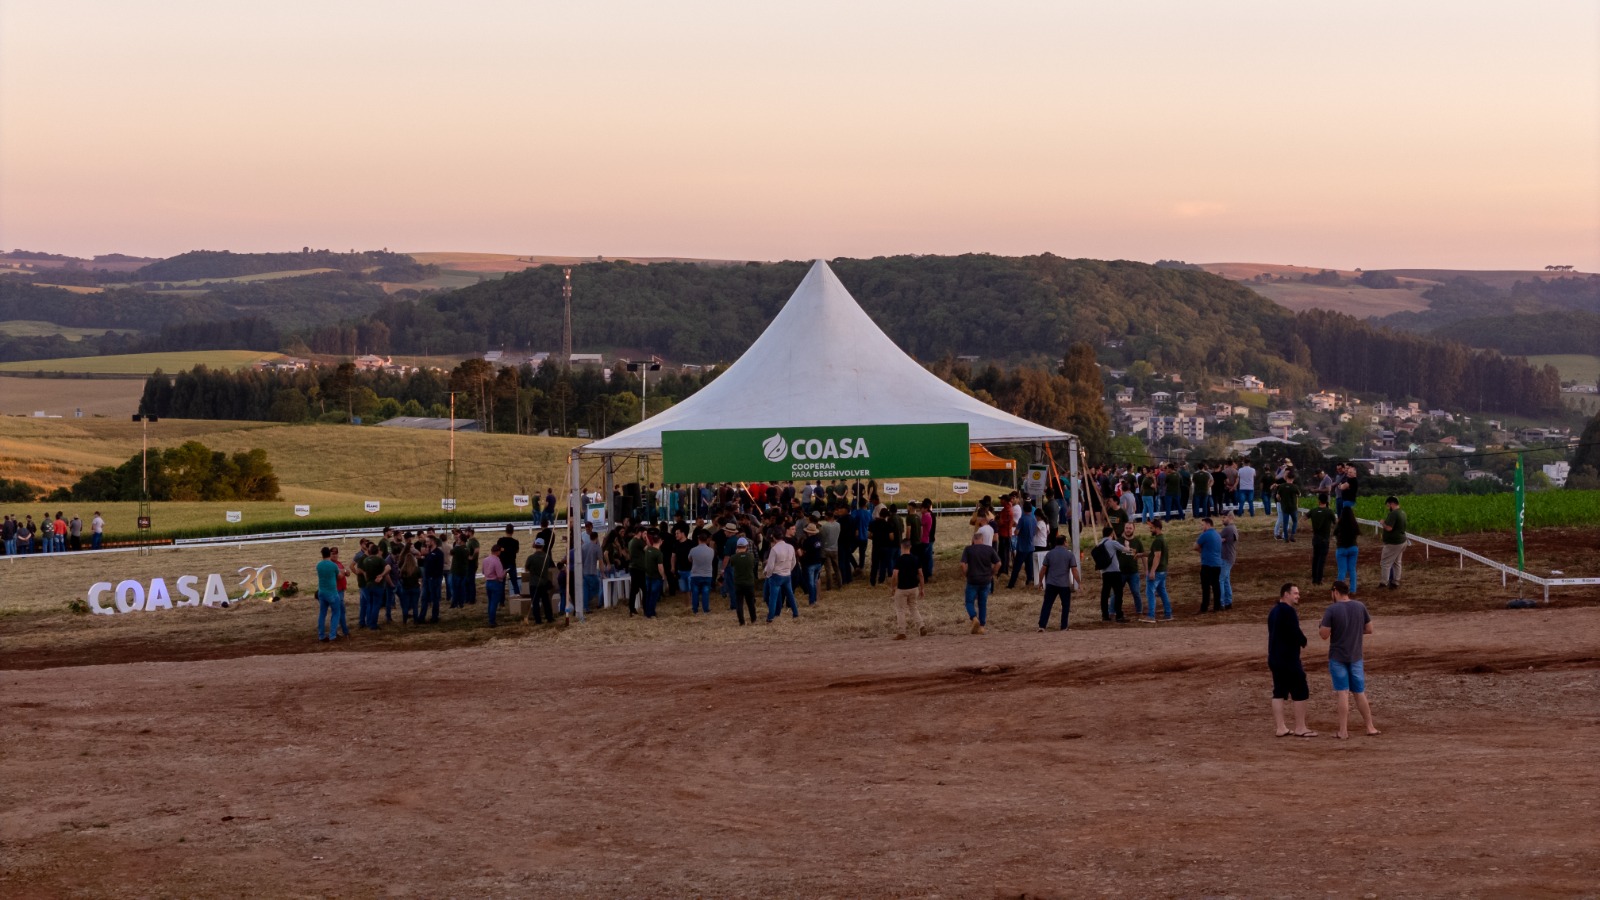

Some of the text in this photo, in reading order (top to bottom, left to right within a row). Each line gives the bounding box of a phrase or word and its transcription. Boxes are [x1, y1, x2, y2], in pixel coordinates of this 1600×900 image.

[791, 437, 869, 459] COASA
[791, 462, 836, 471] COOPERAR
[791, 469, 870, 478] PARA DESENVOLVER
[87, 573, 230, 615] COASA
